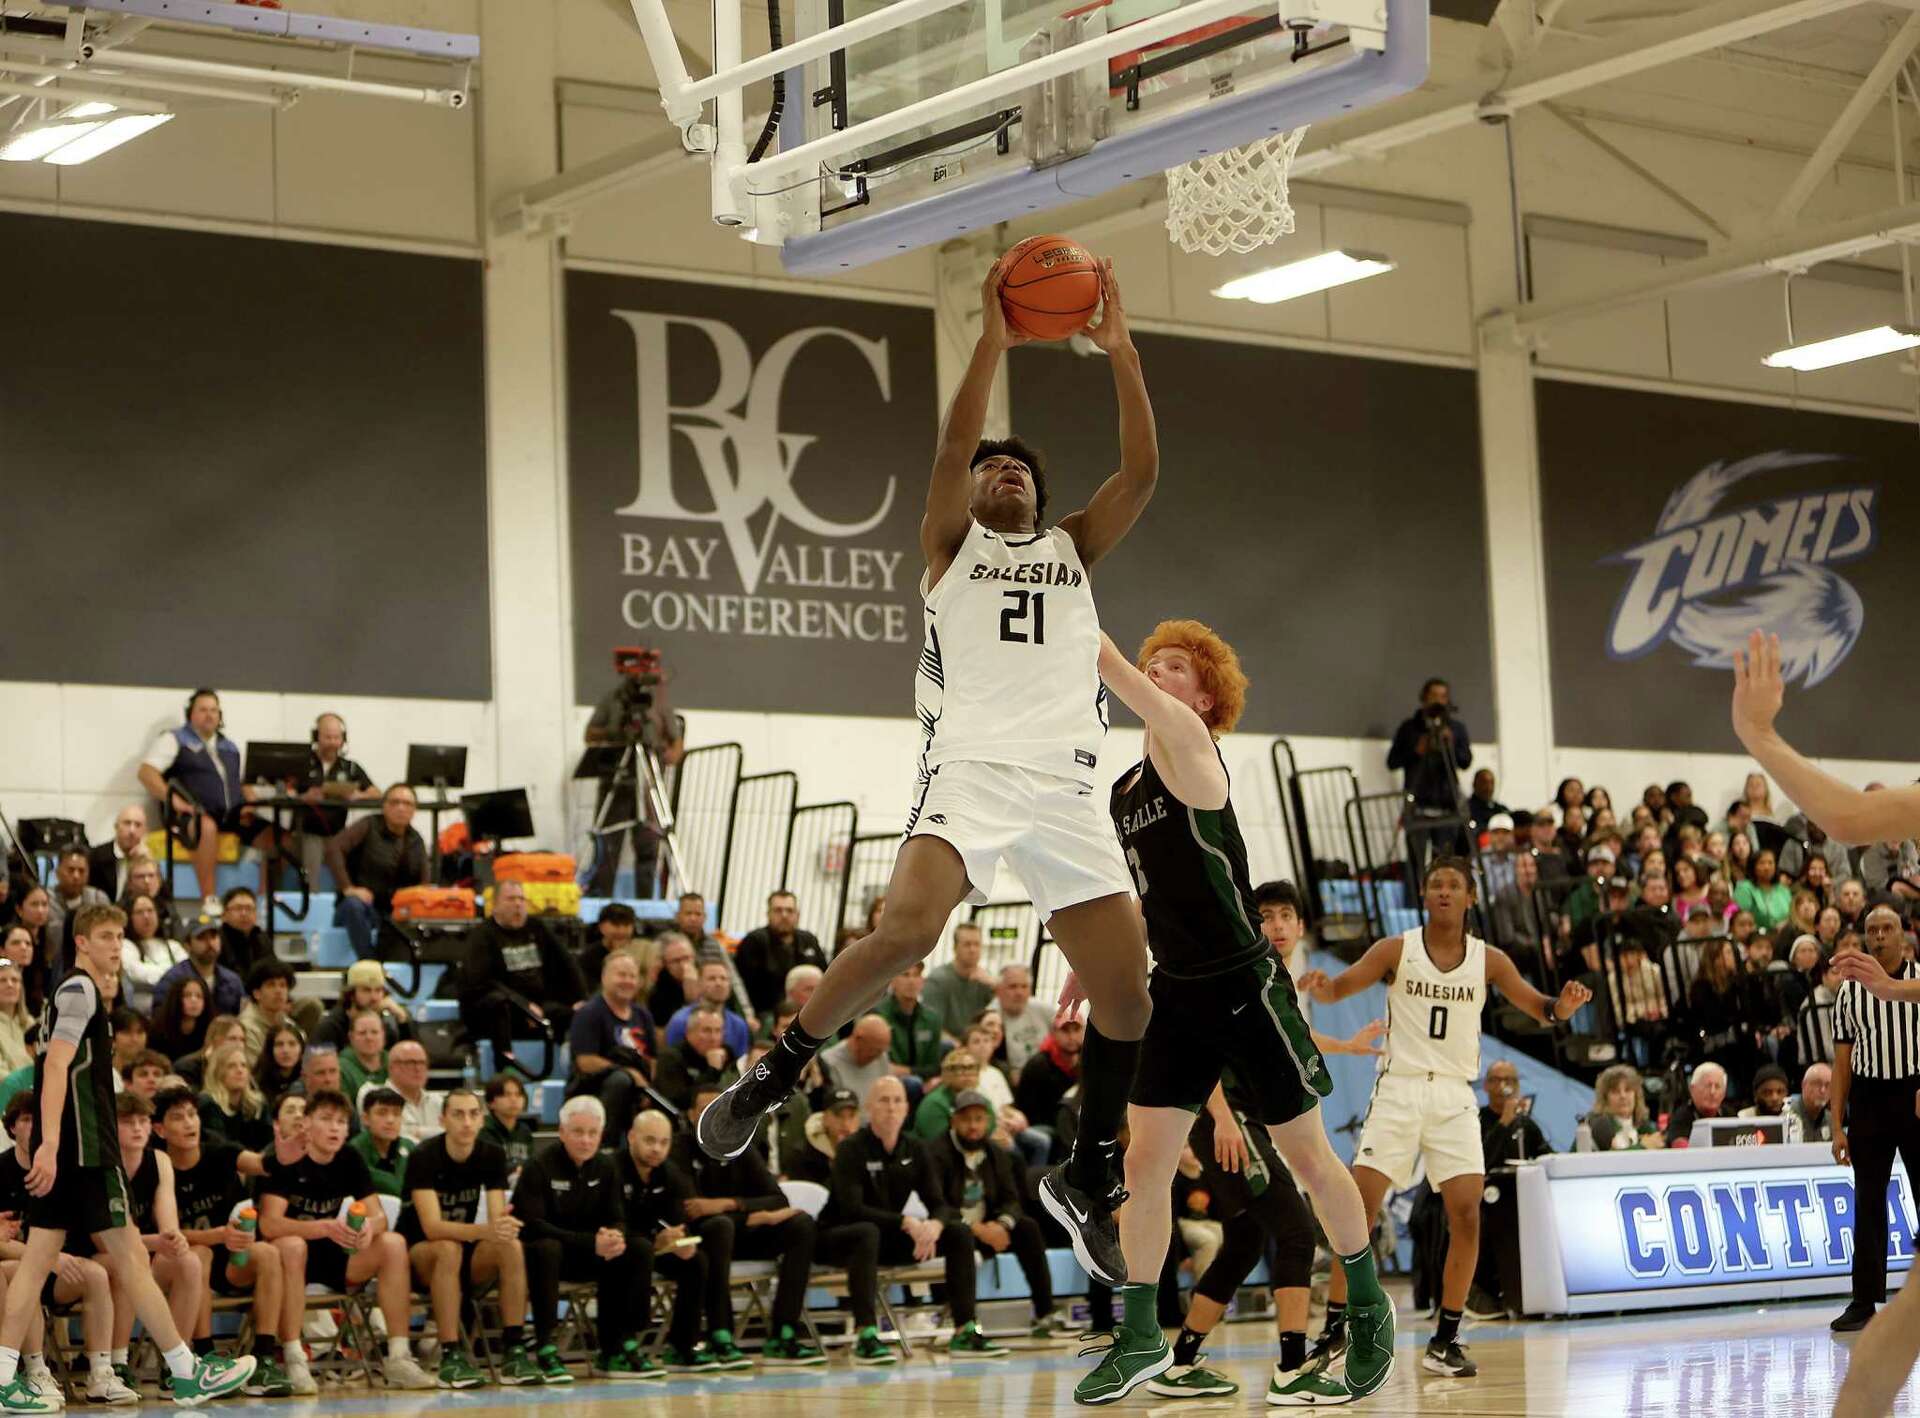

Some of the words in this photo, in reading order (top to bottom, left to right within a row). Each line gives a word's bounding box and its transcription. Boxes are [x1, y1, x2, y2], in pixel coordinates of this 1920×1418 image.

[621, 532, 719, 580] BAY
[969, 561, 1083, 588] SALESIAN
[1608, 486, 1877, 656] COMETS
[621, 588, 908, 643] CONFERENCE
[999, 589, 1045, 645] 21
[1122, 795, 1168, 836] SALLE
[1405, 980, 1475, 1002] SALESIAN
[1429, 1005, 1448, 1041] 0
